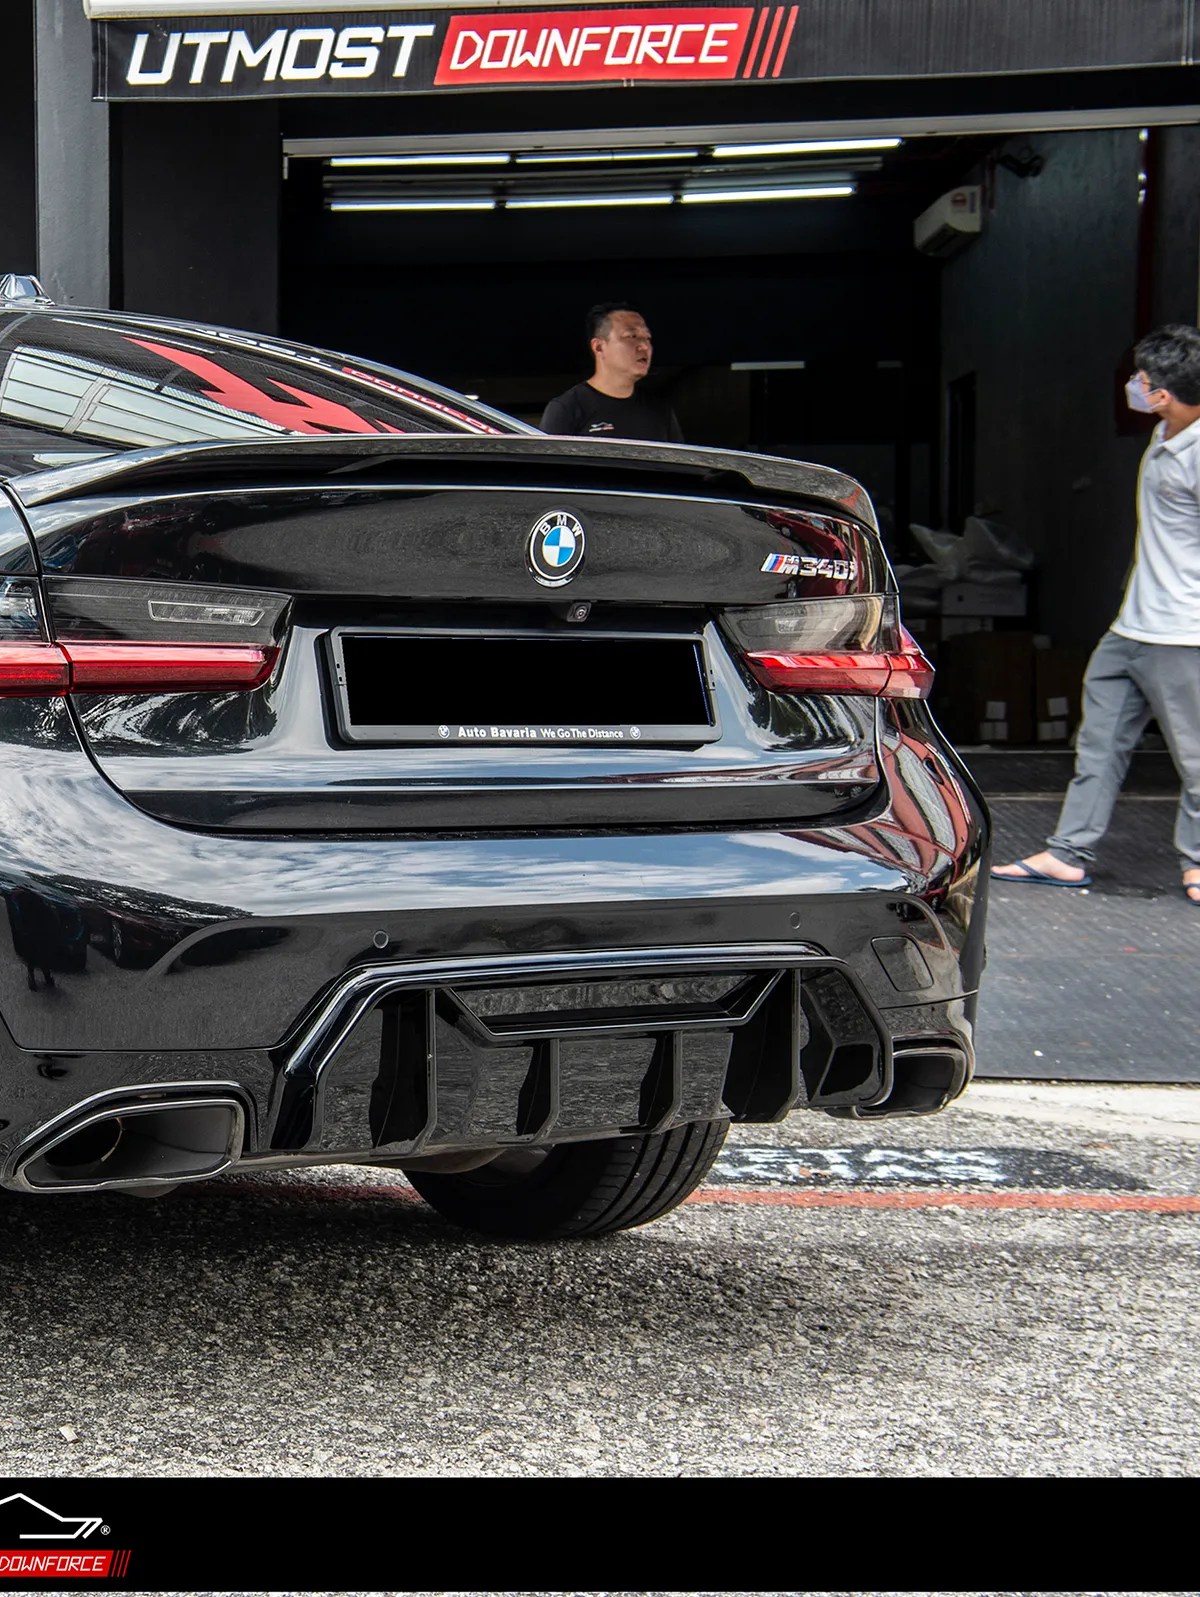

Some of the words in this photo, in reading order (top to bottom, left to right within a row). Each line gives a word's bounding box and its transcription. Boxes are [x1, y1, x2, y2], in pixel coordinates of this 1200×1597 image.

[126, 25, 436, 85] UTMOST
[449, 23, 739, 70] DOWNFORCE
[539, 514, 582, 537] BMW
[458, 726, 487, 738] Auto
[490, 726, 537, 738] Bavaria
[540, 728, 556, 738] We
[557, 728, 571, 738] Go
[571, 728, 587, 738] The
[588, 728, 624, 738] Distance
[719, 1148, 1000, 1166] ETAK
